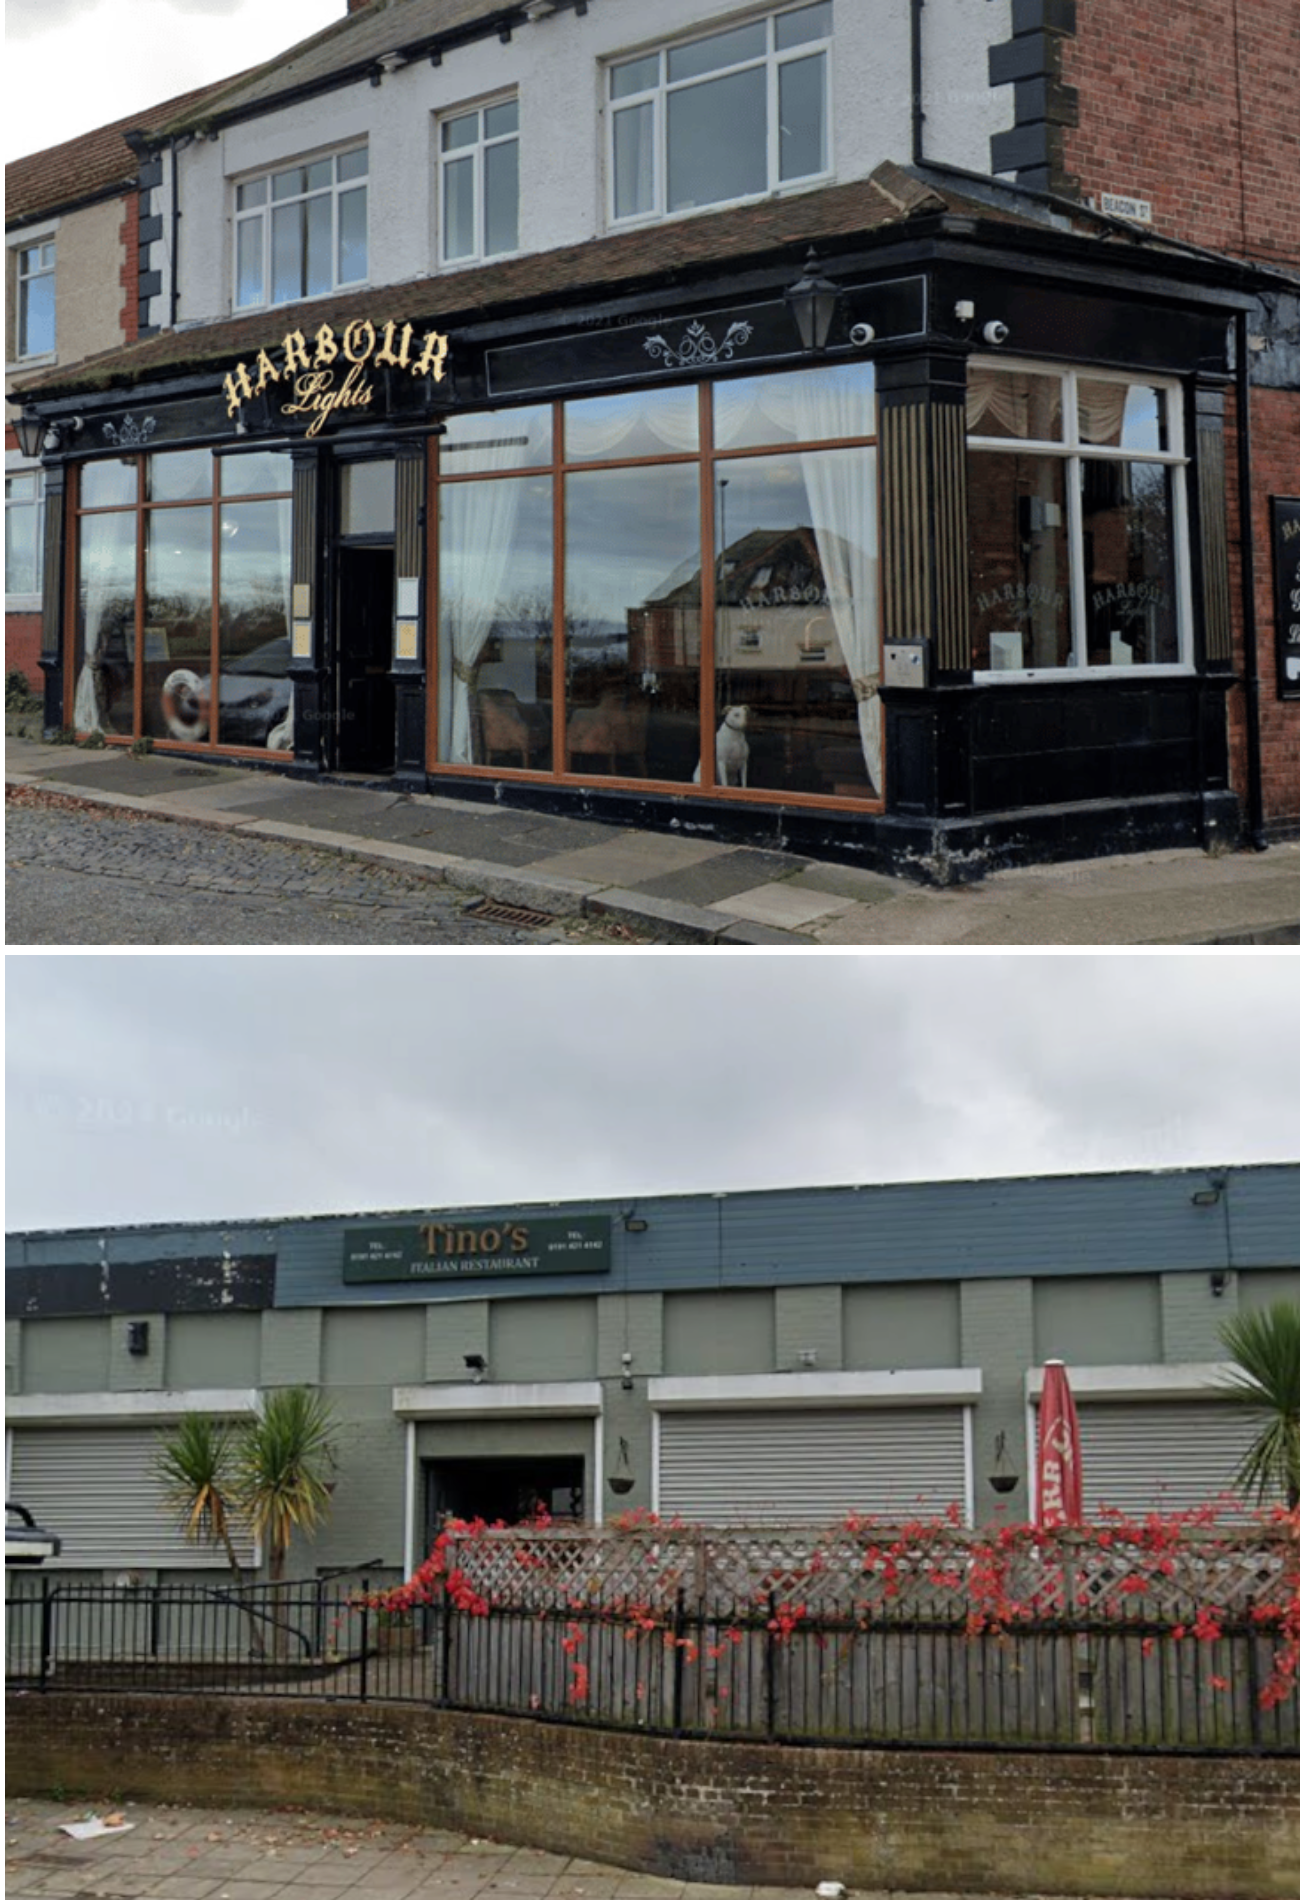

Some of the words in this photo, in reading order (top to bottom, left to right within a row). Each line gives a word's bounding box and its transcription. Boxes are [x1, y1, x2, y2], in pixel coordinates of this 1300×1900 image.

[1102, 196, 1137, 216] BEACON
[222, 319, 448, 418] HARBOUR
[281, 361, 374, 438] Lights
[419, 1222, 530, 1255] Tino's
[410, 1260, 459, 1274] ITALIAN
[460, 1256, 540, 1272] RESTAURANT
